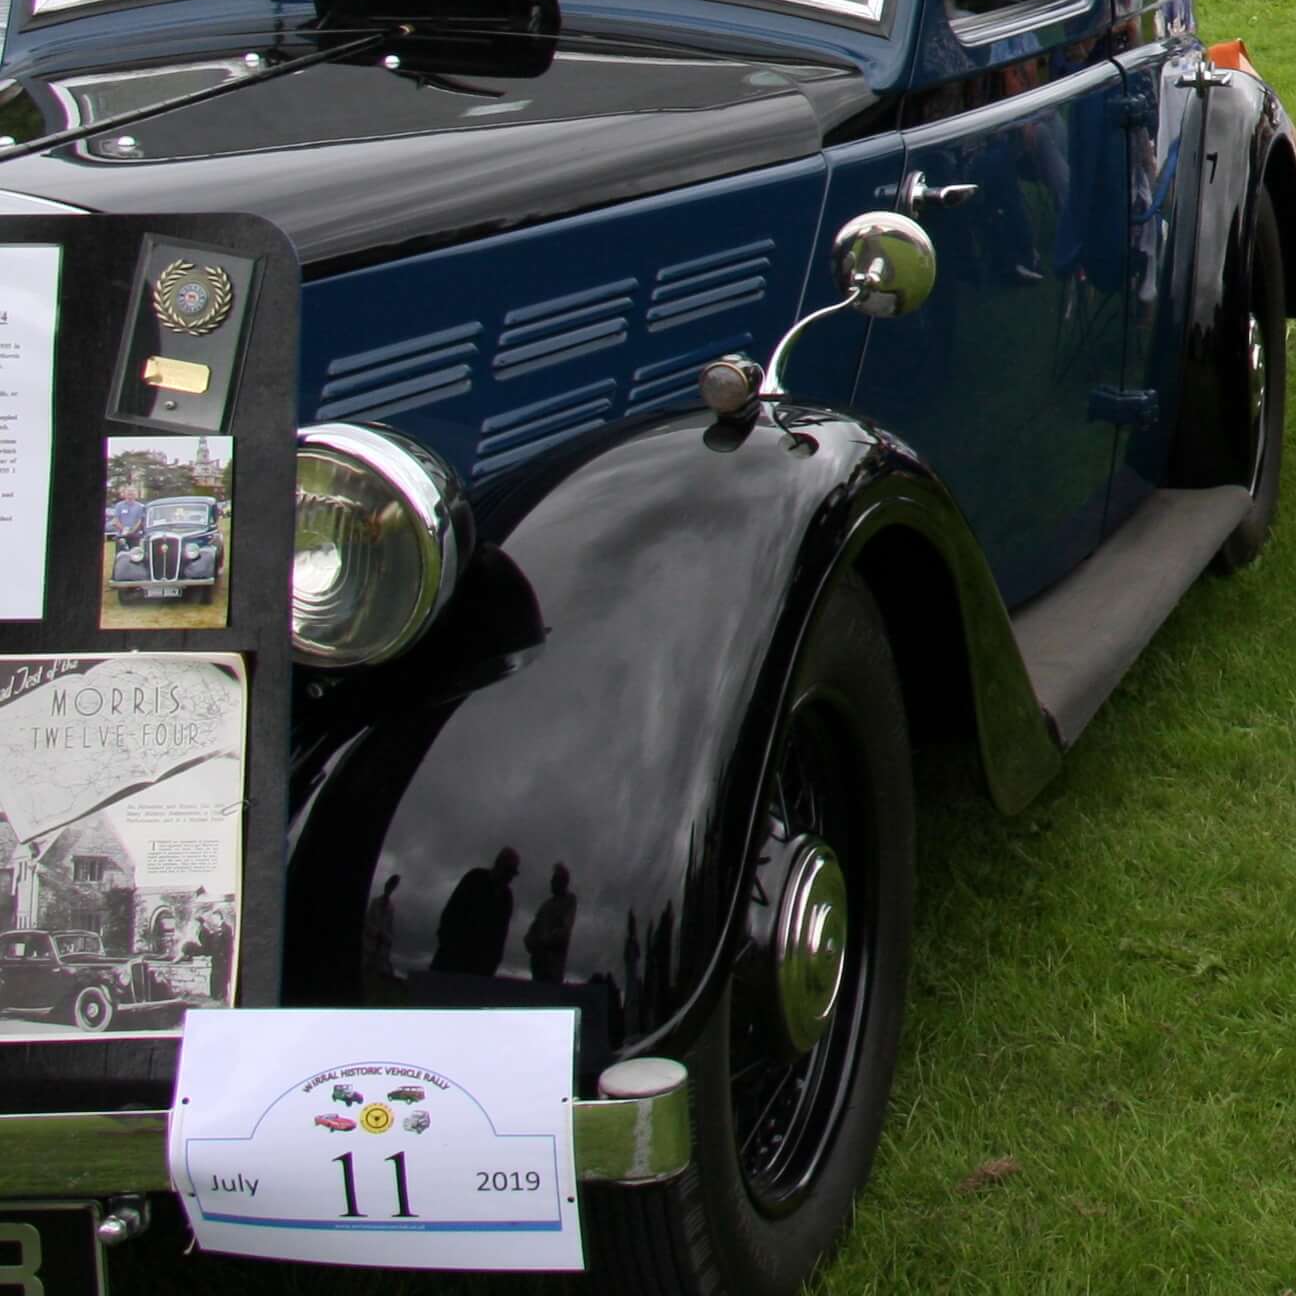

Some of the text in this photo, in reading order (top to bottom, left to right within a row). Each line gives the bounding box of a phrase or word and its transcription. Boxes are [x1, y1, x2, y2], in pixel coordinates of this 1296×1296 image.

[51, 685, 181, 717] MORRIS
[302, 1066, 451, 1093] WIRRAL HISTORIC VEHICLE RALLY
[209, 1150, 541, 1219] July 11 2019
